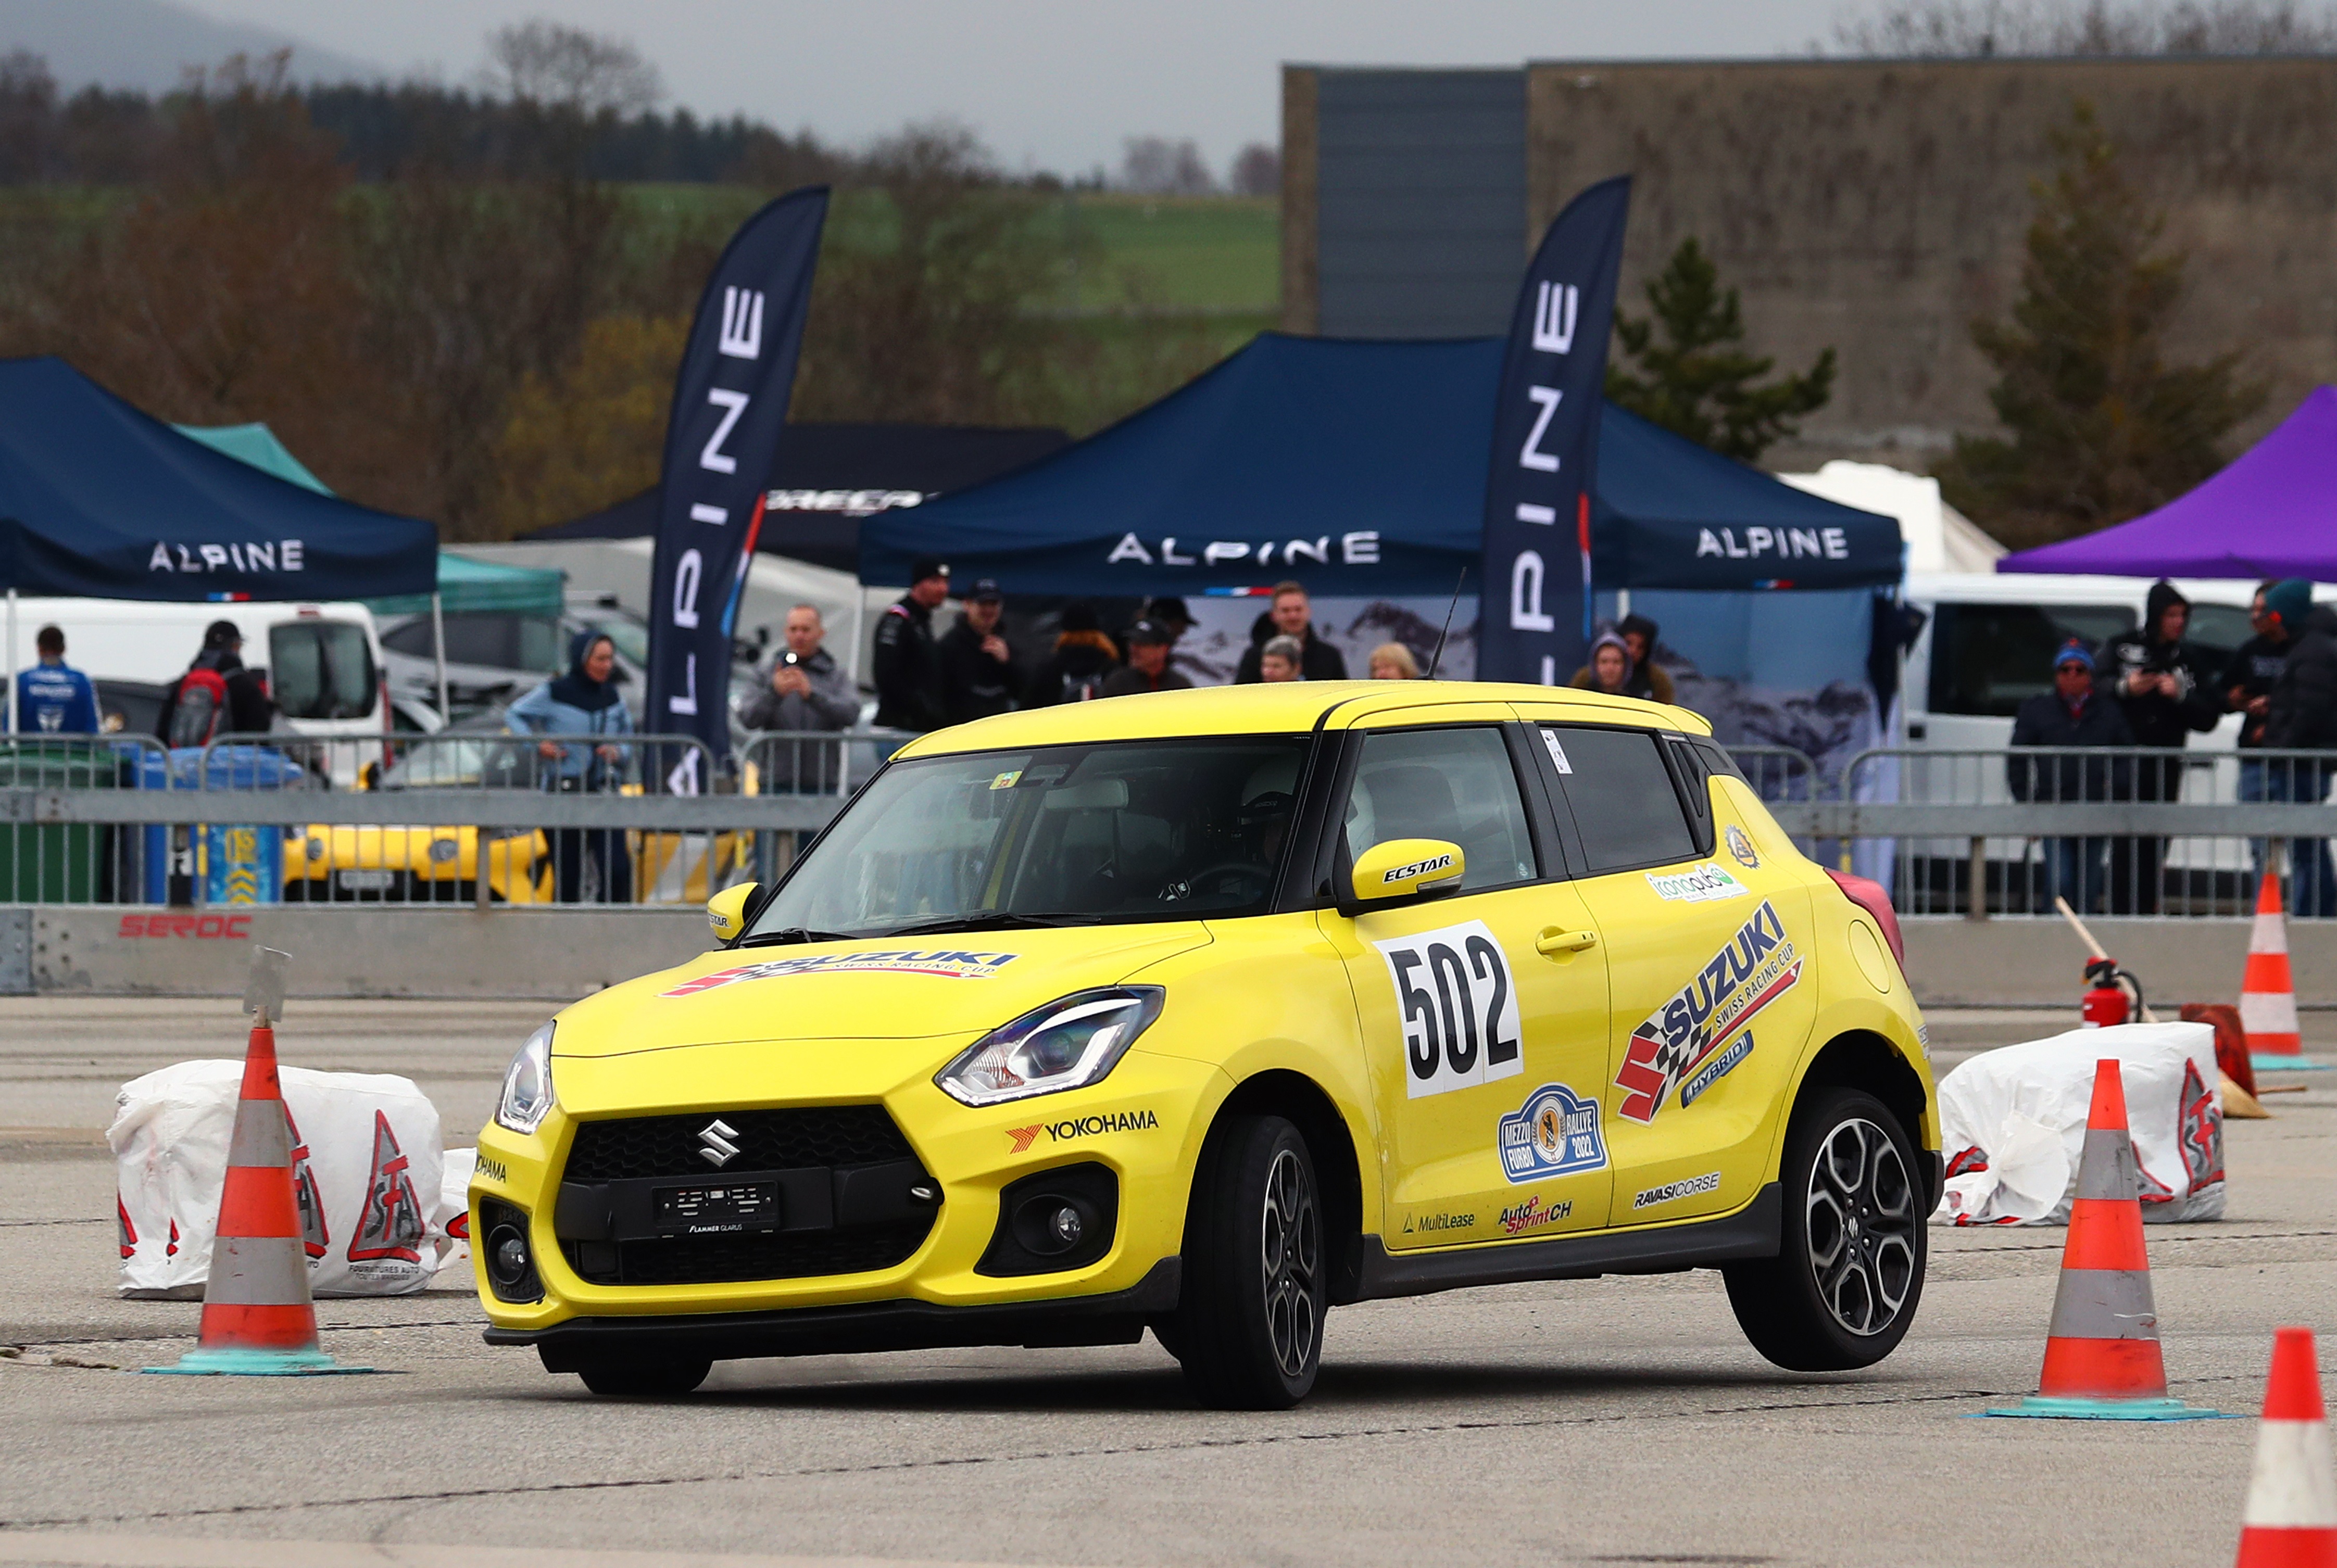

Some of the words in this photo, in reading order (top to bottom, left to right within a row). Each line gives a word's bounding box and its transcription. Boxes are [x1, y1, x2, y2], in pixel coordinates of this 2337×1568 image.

[1510, 280, 1578, 685] PINE
[149, 539, 304, 573] ALPINE
[1107, 530, 1380, 566] ALPINE
[1697, 526, 1849, 560] ALPINE
[1384, 855, 1454, 882] ECSTAR
[118, 915, 251, 939] SEROC
[708, 913, 730, 927] STAR
[765, 952, 1017, 970] SUZUKI
[891, 962, 956, 970] RACING
[961, 965, 995, 973] CUP
[1664, 901, 1785, 1047] SUZUKI
[1715, 994, 1744, 1029] SWISS
[1745, 961, 1778, 1000] RACING
[1778, 942, 1794, 967] CUP
[1389, 935, 1518, 1080] 502
[1692, 1042, 1743, 1096] HYBRID
[1045, 1110, 1159, 1142] YOKOHAMA
[1505, 1121, 1530, 1147] MEZZO
[1566, 1110, 1592, 1135] RALLYE
[1507, 1146, 1535, 1170] FURBO
[1572, 1135, 1594, 1159] 2022
[476, 1155, 506, 1183] OHAMA
[1418, 1213, 1475, 1232] MultiLease
